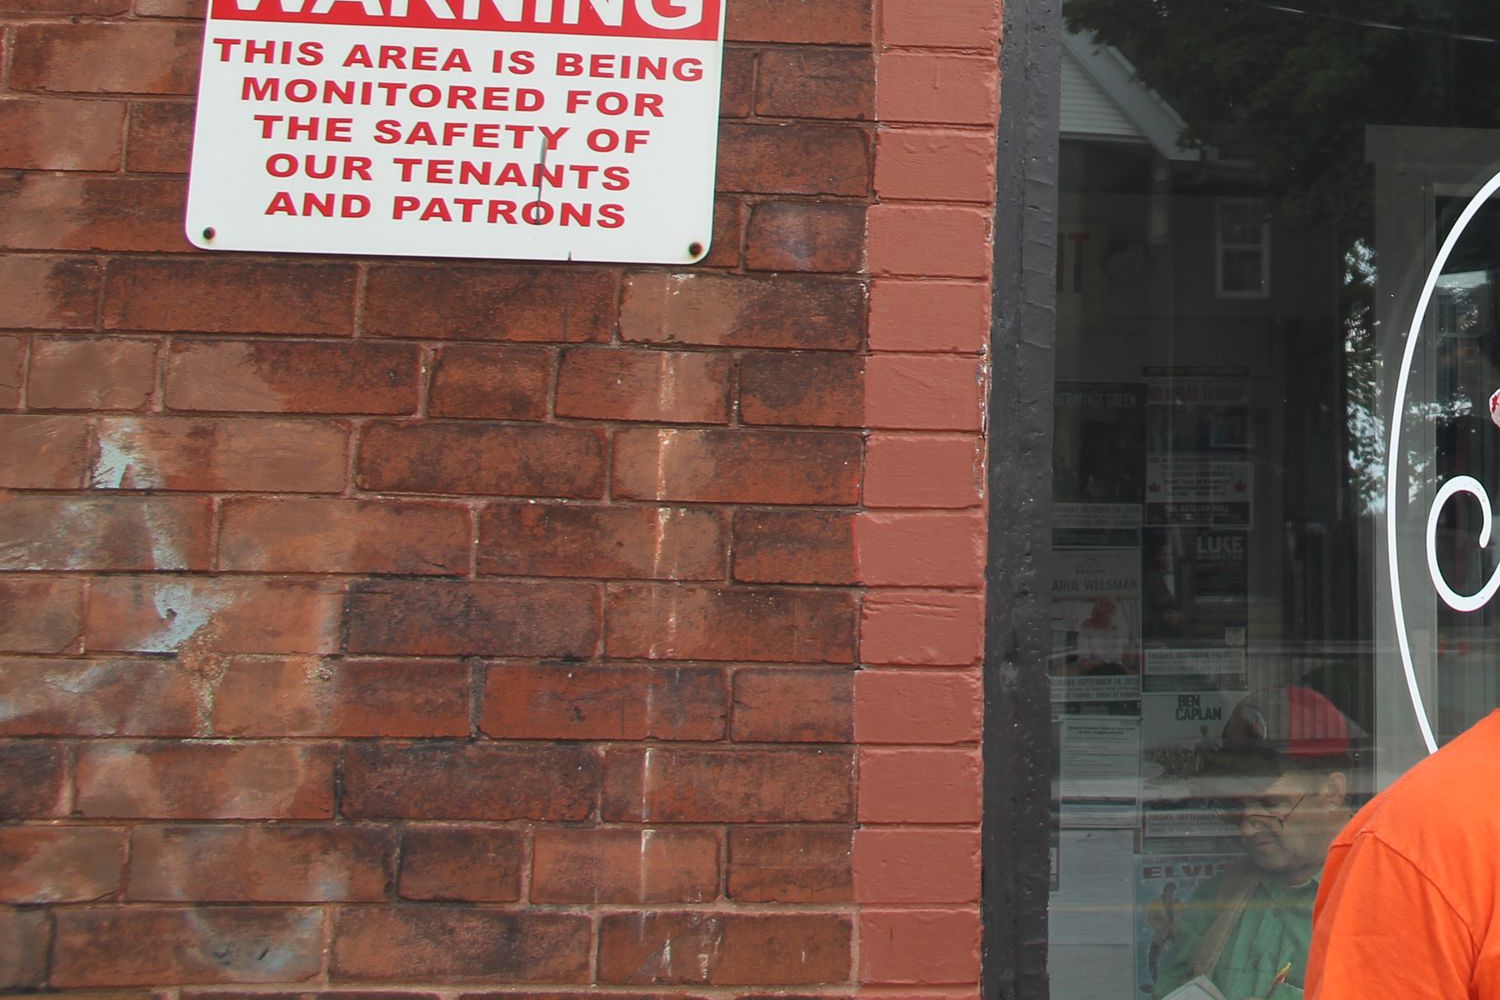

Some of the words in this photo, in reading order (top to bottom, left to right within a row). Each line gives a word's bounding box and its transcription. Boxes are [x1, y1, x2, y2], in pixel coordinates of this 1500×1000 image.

[213, 37, 325, 68] THIS
[342, 43, 473, 73] AREA
[491, 49, 536, 75] IS
[555, 53, 705, 83] BEING
[241, 76, 546, 113] MONITORED
[566, 89, 666, 118] FOR
[253, 114, 354, 143] THE
[373, 119, 571, 151] SAFETY
[586, 129, 651, 154] OF
[265, 152, 374, 180] OUR
[393, 157, 631, 191] TENANTS
[264, 191, 372, 220] AND
[392, 196, 627, 229] PATRONS
[1196, 536, 1244, 554] LUKE
[1175, 707, 1222, 721] CAPLAN
[1178, 694, 1200, 707] BEN
